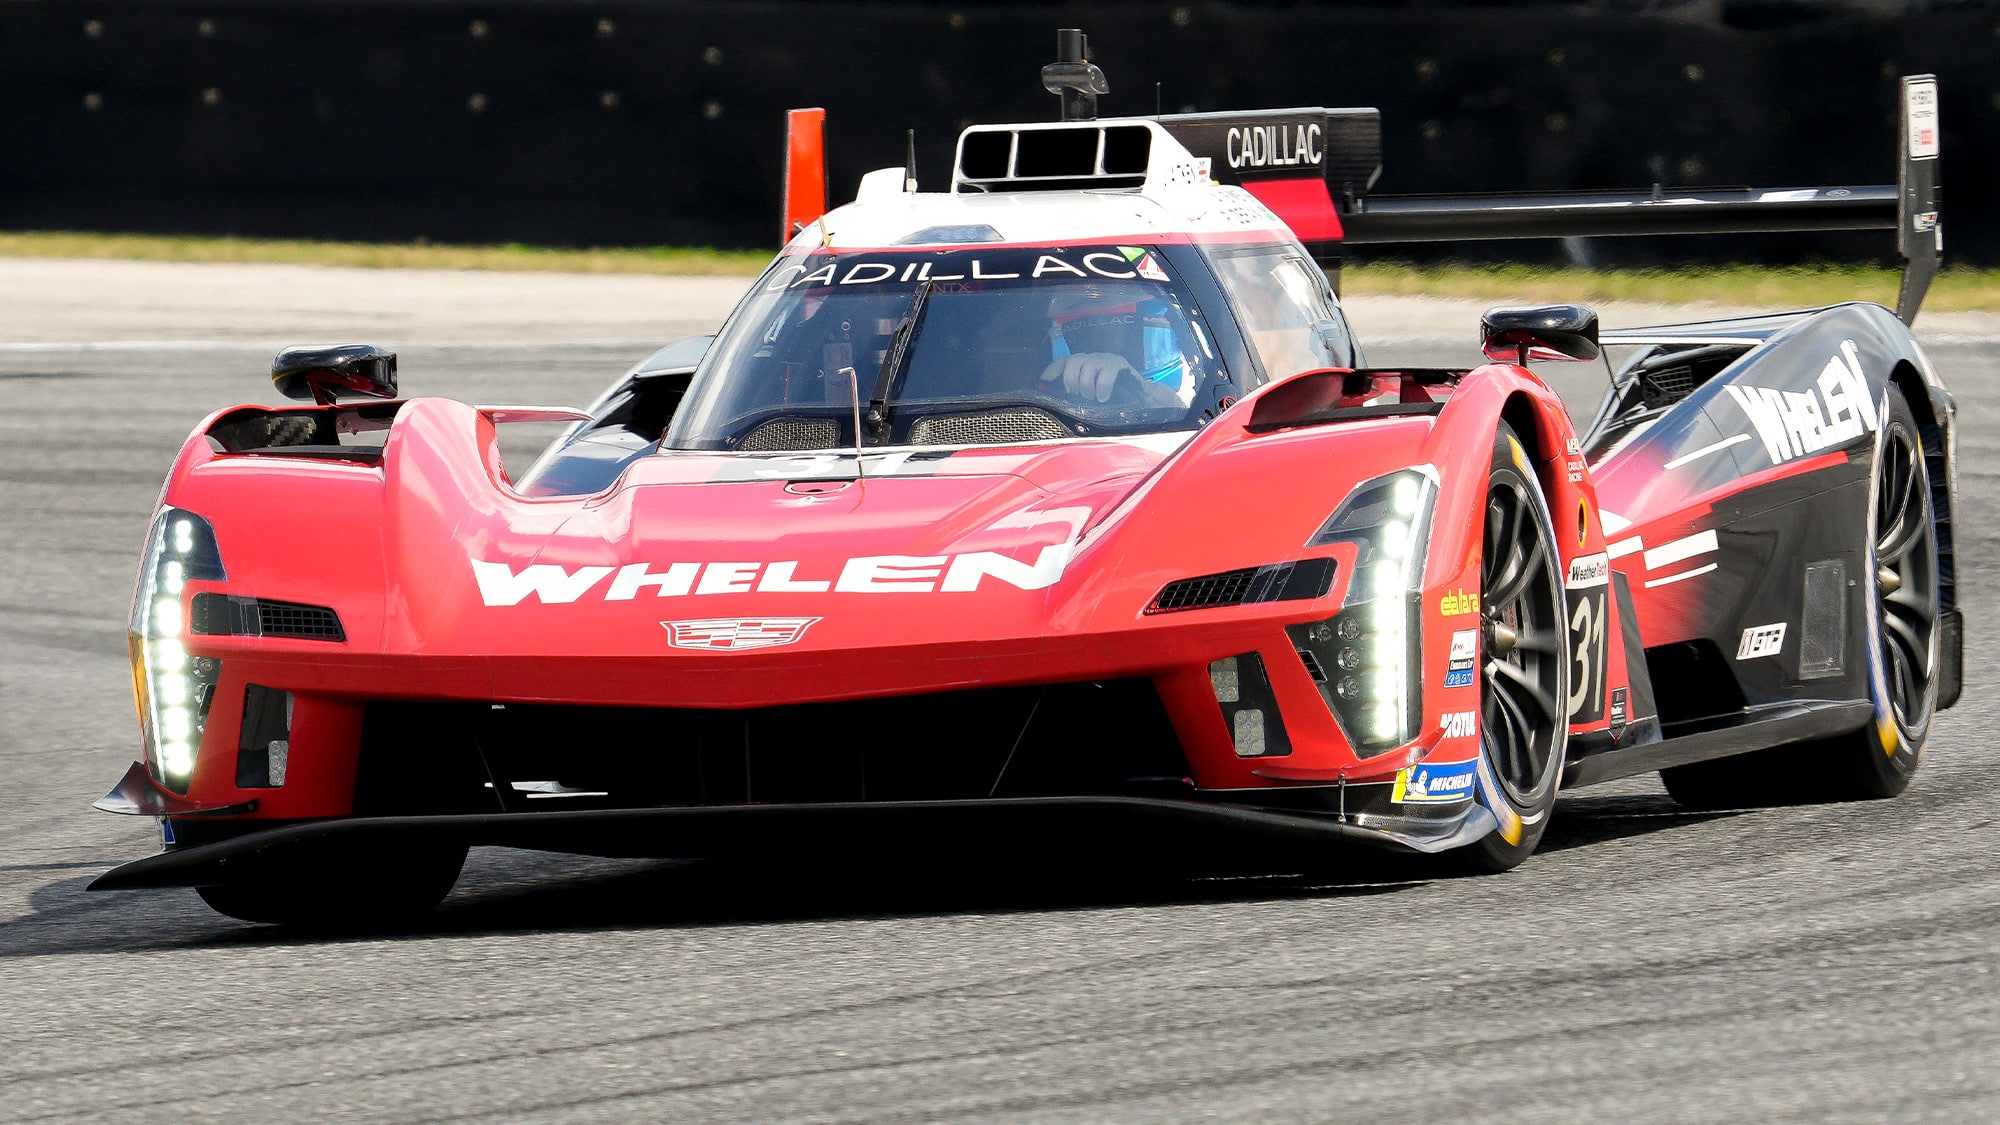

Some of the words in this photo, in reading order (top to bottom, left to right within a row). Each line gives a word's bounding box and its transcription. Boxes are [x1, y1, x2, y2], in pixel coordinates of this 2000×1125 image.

[1226, 123, 1322, 169] CADILLAC
[766, 252, 1136, 292] CADILLAC
[1722, 339, 1878, 465] WHELEN
[470, 541, 1077, 607] WHELEN
[1440, 587, 1479, 617] dallara
[1569, 592, 1605, 716] 31
[1439, 711, 1477, 738] MOTUL
[1428, 773, 1474, 791] MICHELIN
